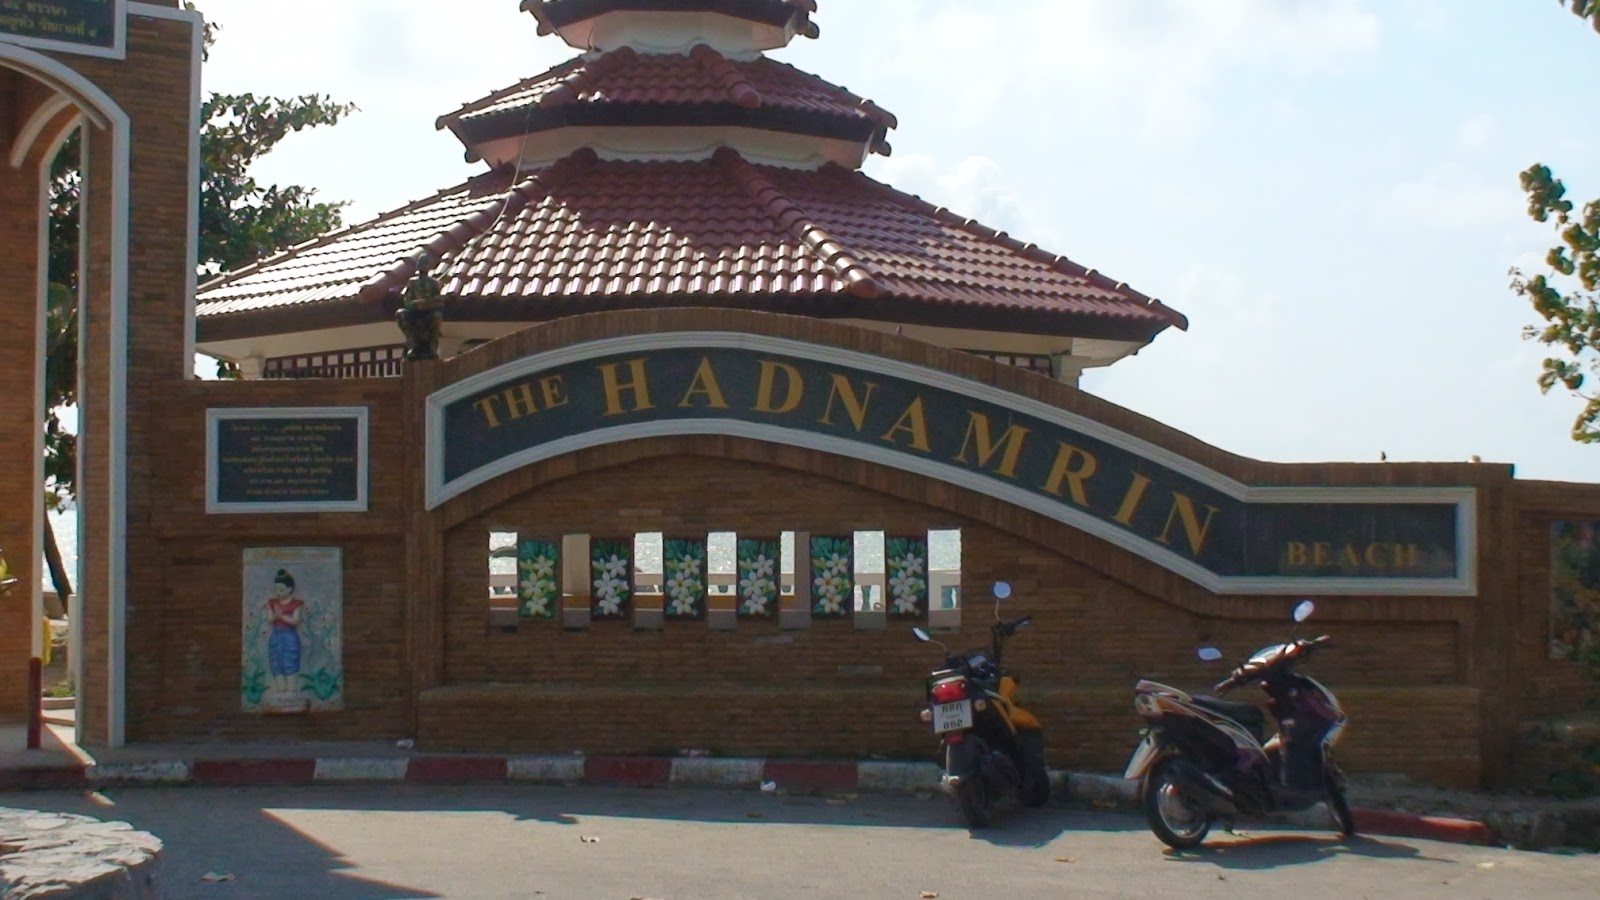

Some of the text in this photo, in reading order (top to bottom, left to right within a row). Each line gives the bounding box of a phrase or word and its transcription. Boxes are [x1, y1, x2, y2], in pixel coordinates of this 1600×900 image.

[473, 355, 1221, 556] THE HADNAMRIN
[1287, 541, 1419, 567] BEACH
